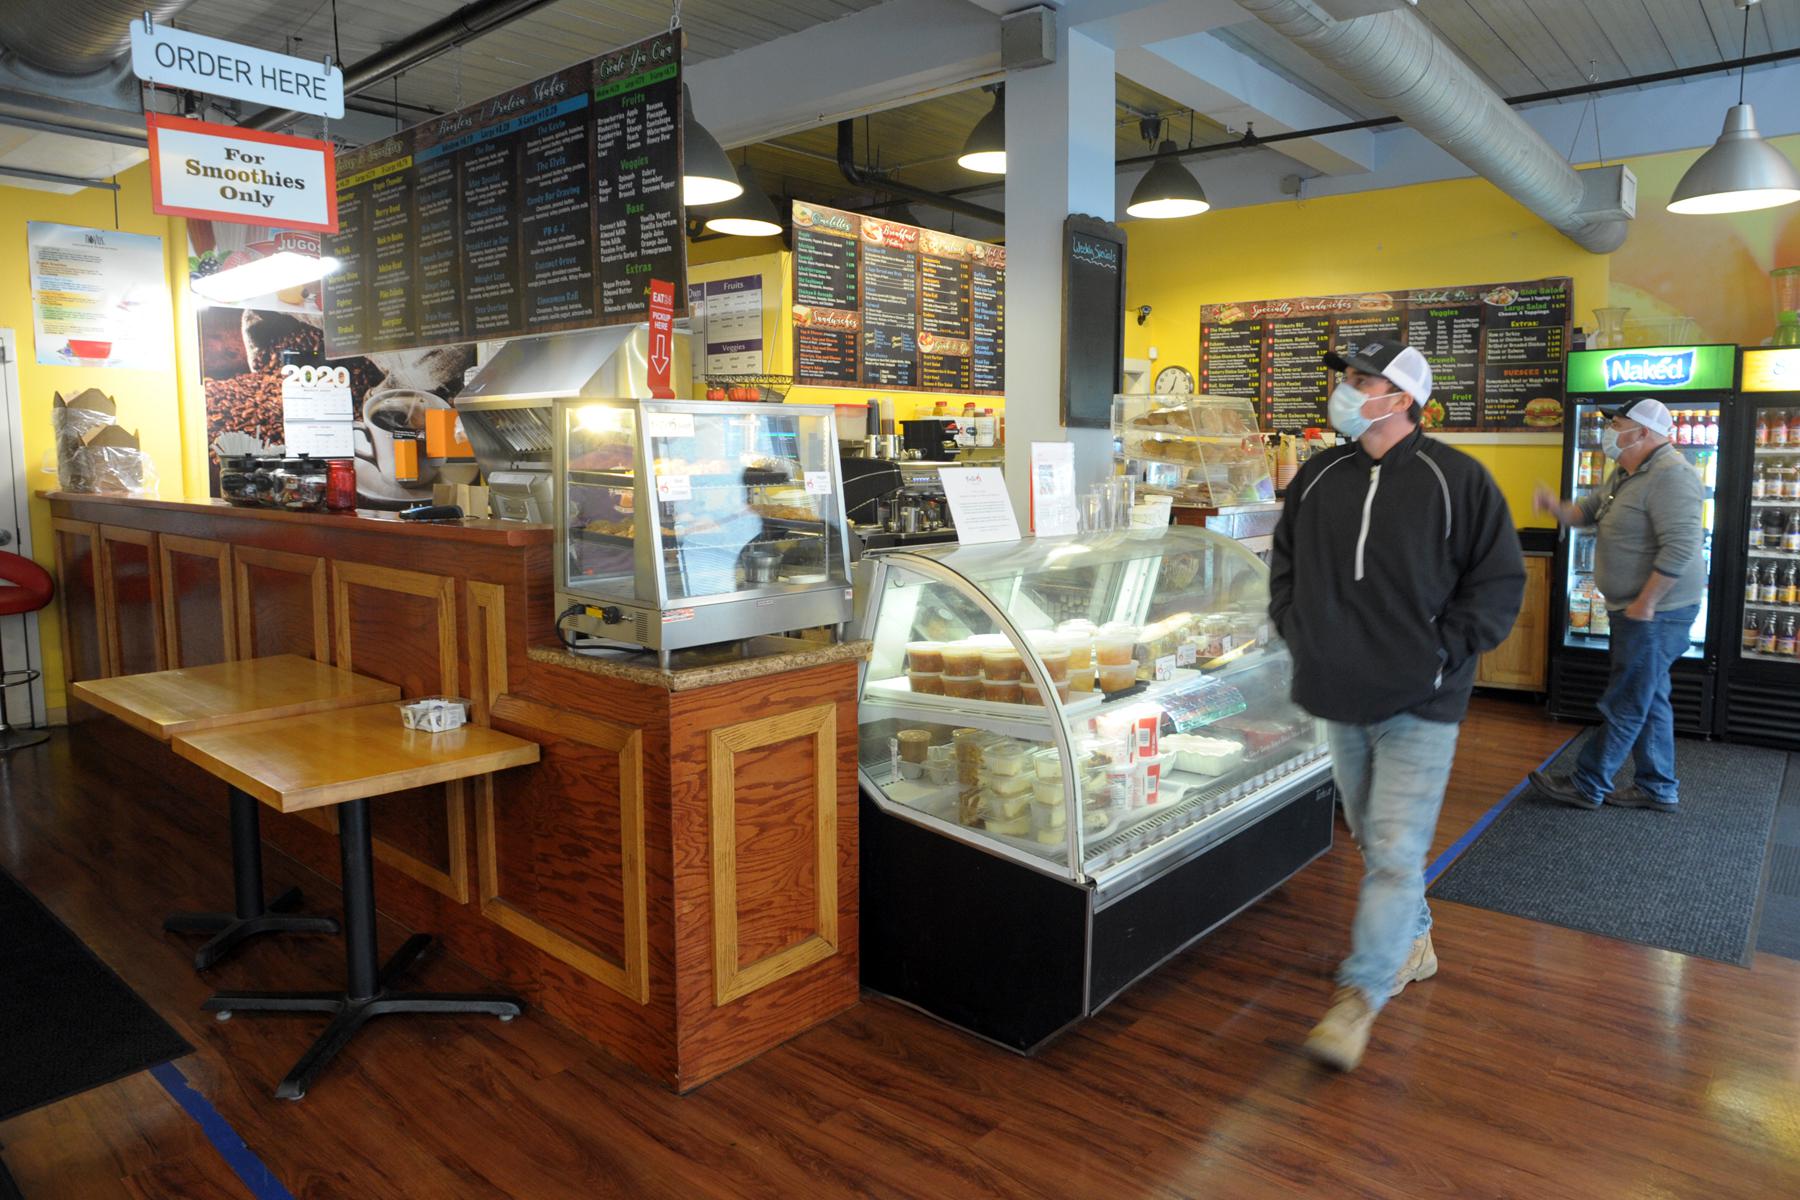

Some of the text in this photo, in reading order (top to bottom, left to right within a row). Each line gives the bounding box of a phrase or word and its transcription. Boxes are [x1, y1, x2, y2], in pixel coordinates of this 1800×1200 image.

[155, 41, 329, 101] ORDER HERE
[224, 147, 265, 166] For
[185, 158, 306, 190] Smoothies
[219, 185, 275, 208] Only
[724, 282, 744, 290] Fruits
[814, 310, 857, 328] Sandwiches
[1251, 302, 1292, 318] Specialty
[1430, 309, 1458, 317] Veggies
[722, 344, 746, 352] Veggies
[281, 364, 350, 388] 2020
